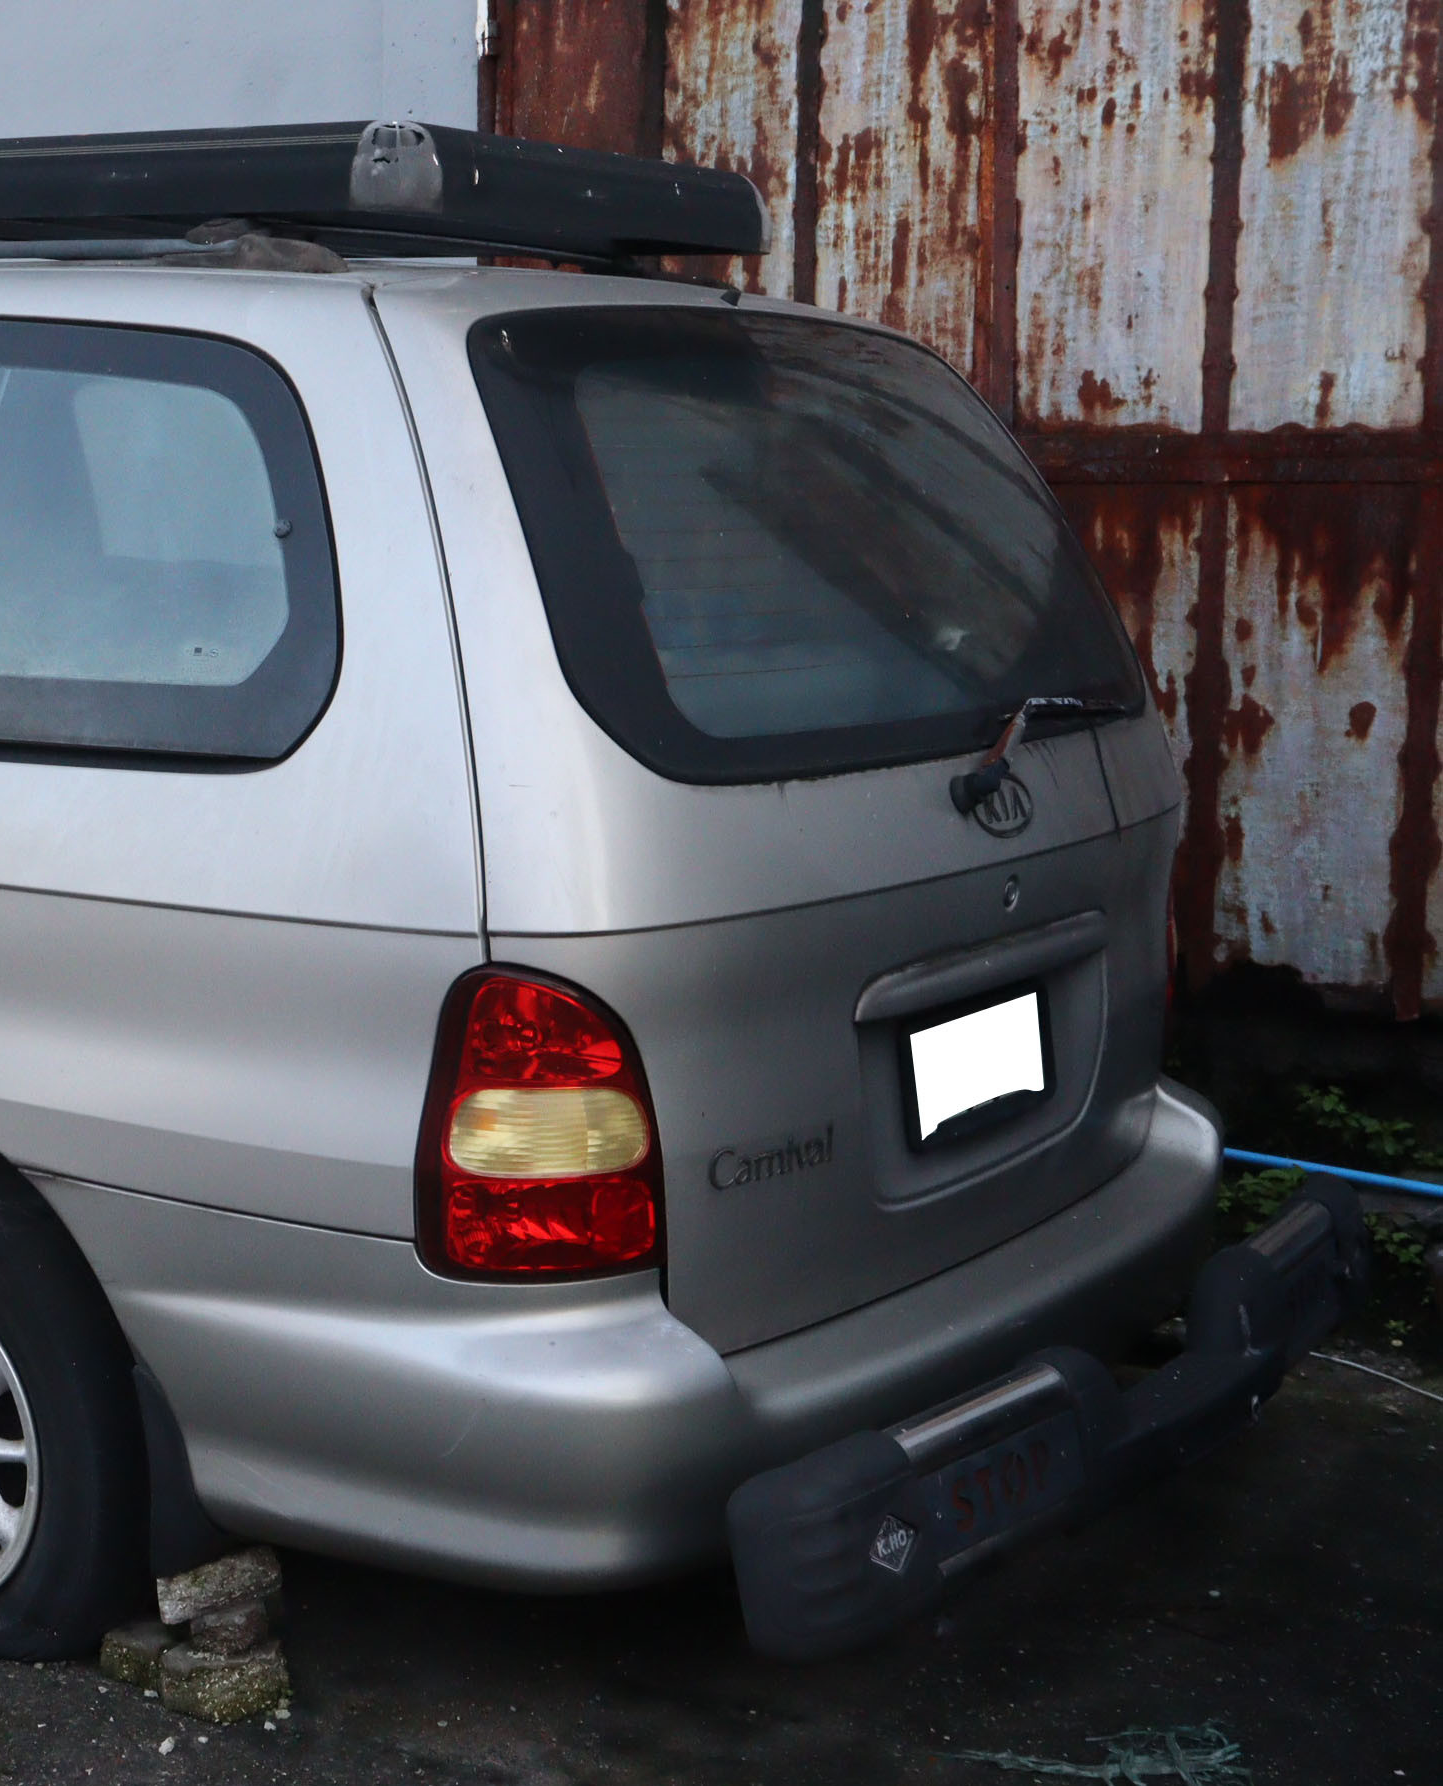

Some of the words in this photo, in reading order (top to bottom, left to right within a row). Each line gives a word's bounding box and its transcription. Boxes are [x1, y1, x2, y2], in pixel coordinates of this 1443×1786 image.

[983, 784, 1027, 825] KIA
[709, 1125, 834, 1190] Carnival
[952, 1439, 1050, 1532] STOP
